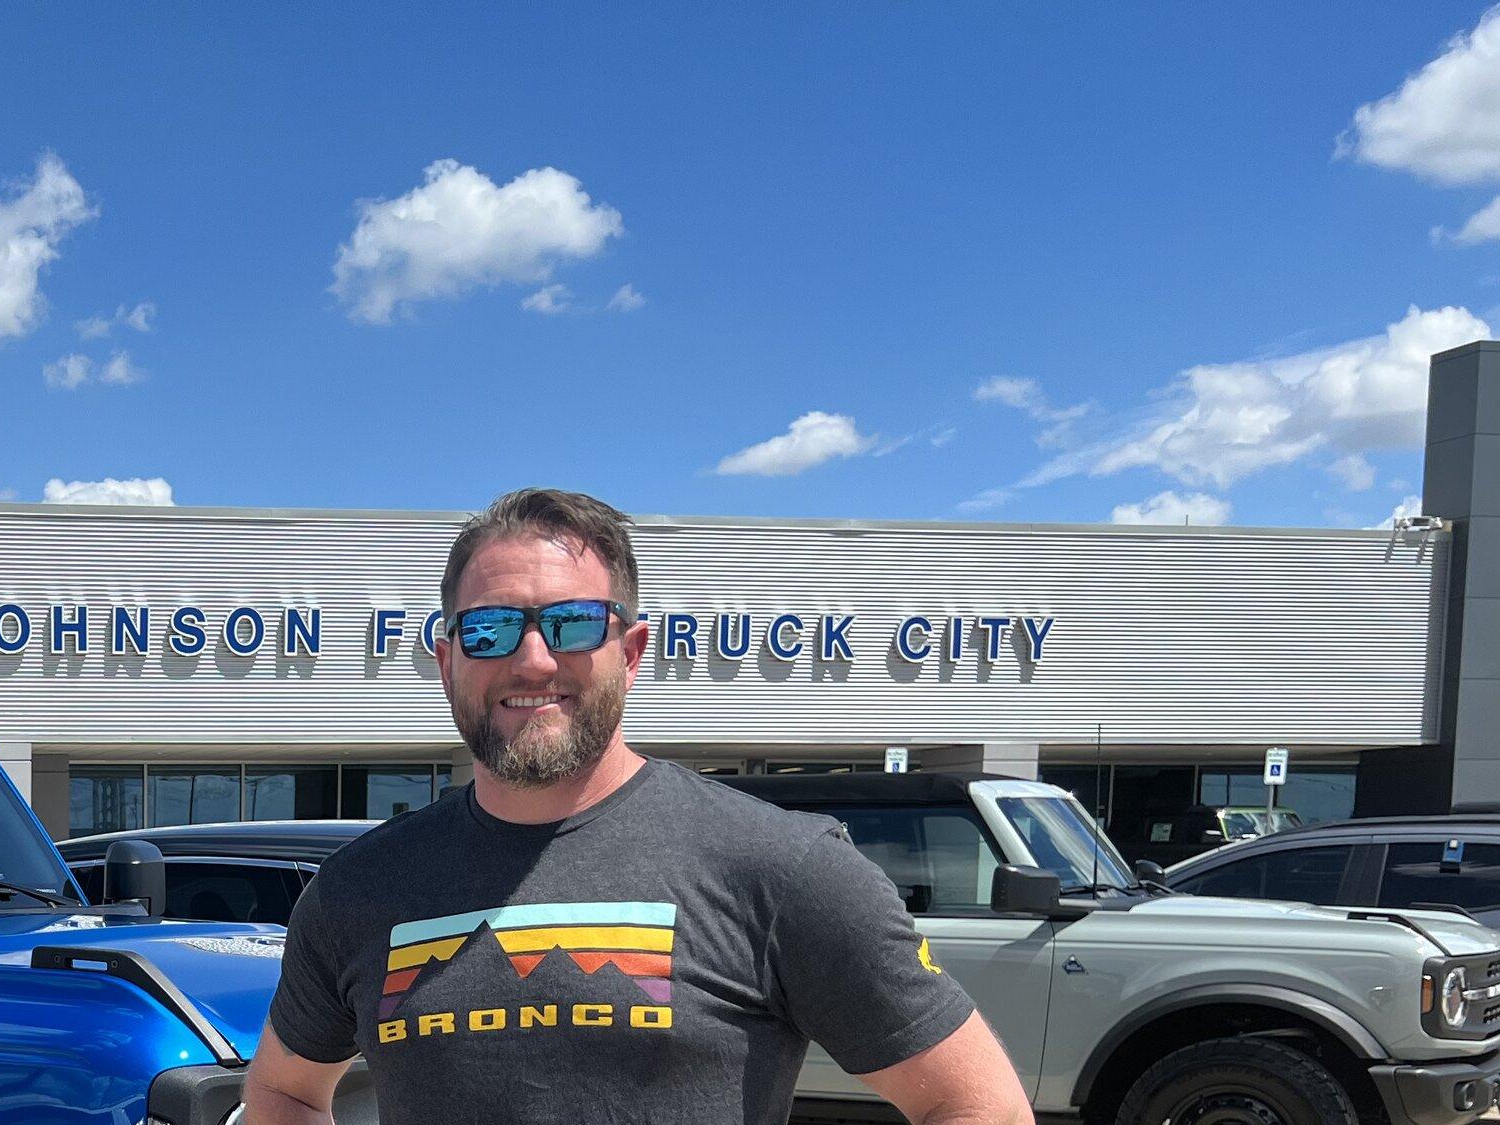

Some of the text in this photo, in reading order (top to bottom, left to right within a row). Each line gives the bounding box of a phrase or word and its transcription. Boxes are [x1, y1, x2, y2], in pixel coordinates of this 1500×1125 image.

[637, 612, 857, 661] RUCK
[899, 615, 1056, 662] CITY
[378, 1004, 673, 1044] BRONCO
